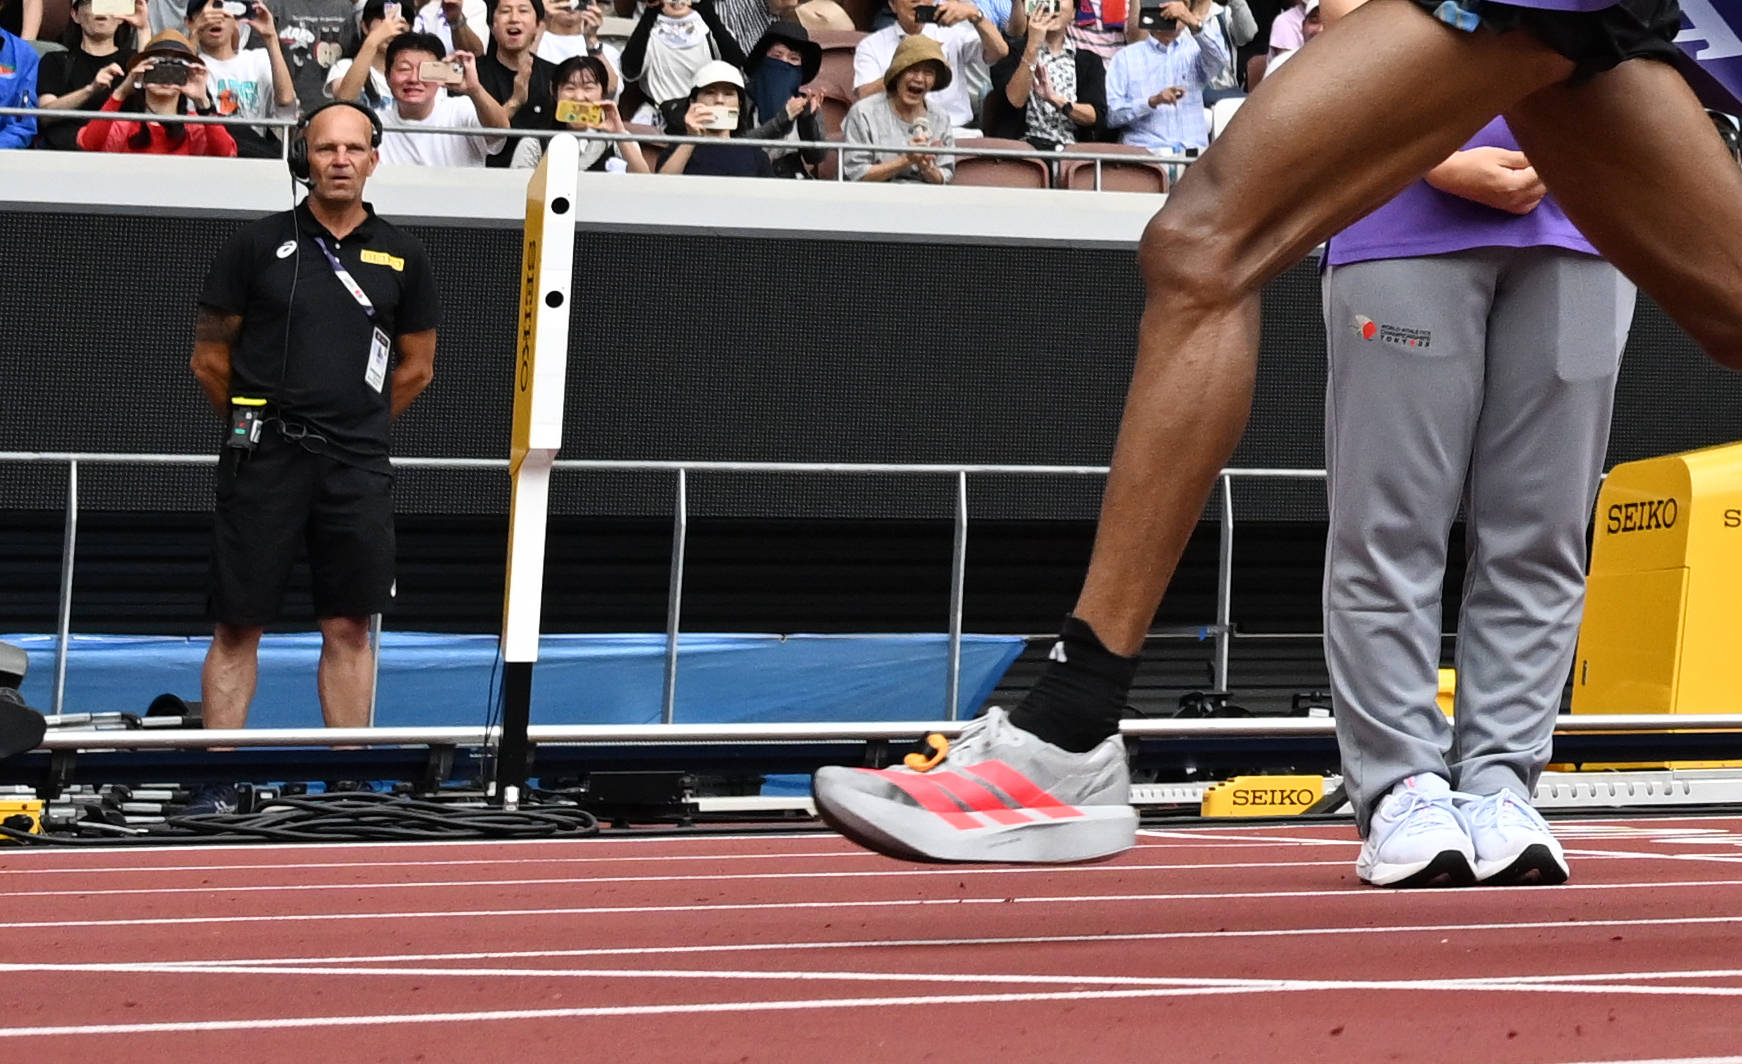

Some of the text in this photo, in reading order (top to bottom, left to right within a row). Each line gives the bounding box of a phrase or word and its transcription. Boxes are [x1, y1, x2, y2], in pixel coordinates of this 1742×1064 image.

[520, 239, 537, 393] SEIKO
[1607, 497, 1678, 535] SEIKO
[1232, 789, 1314, 806] SEIKO
